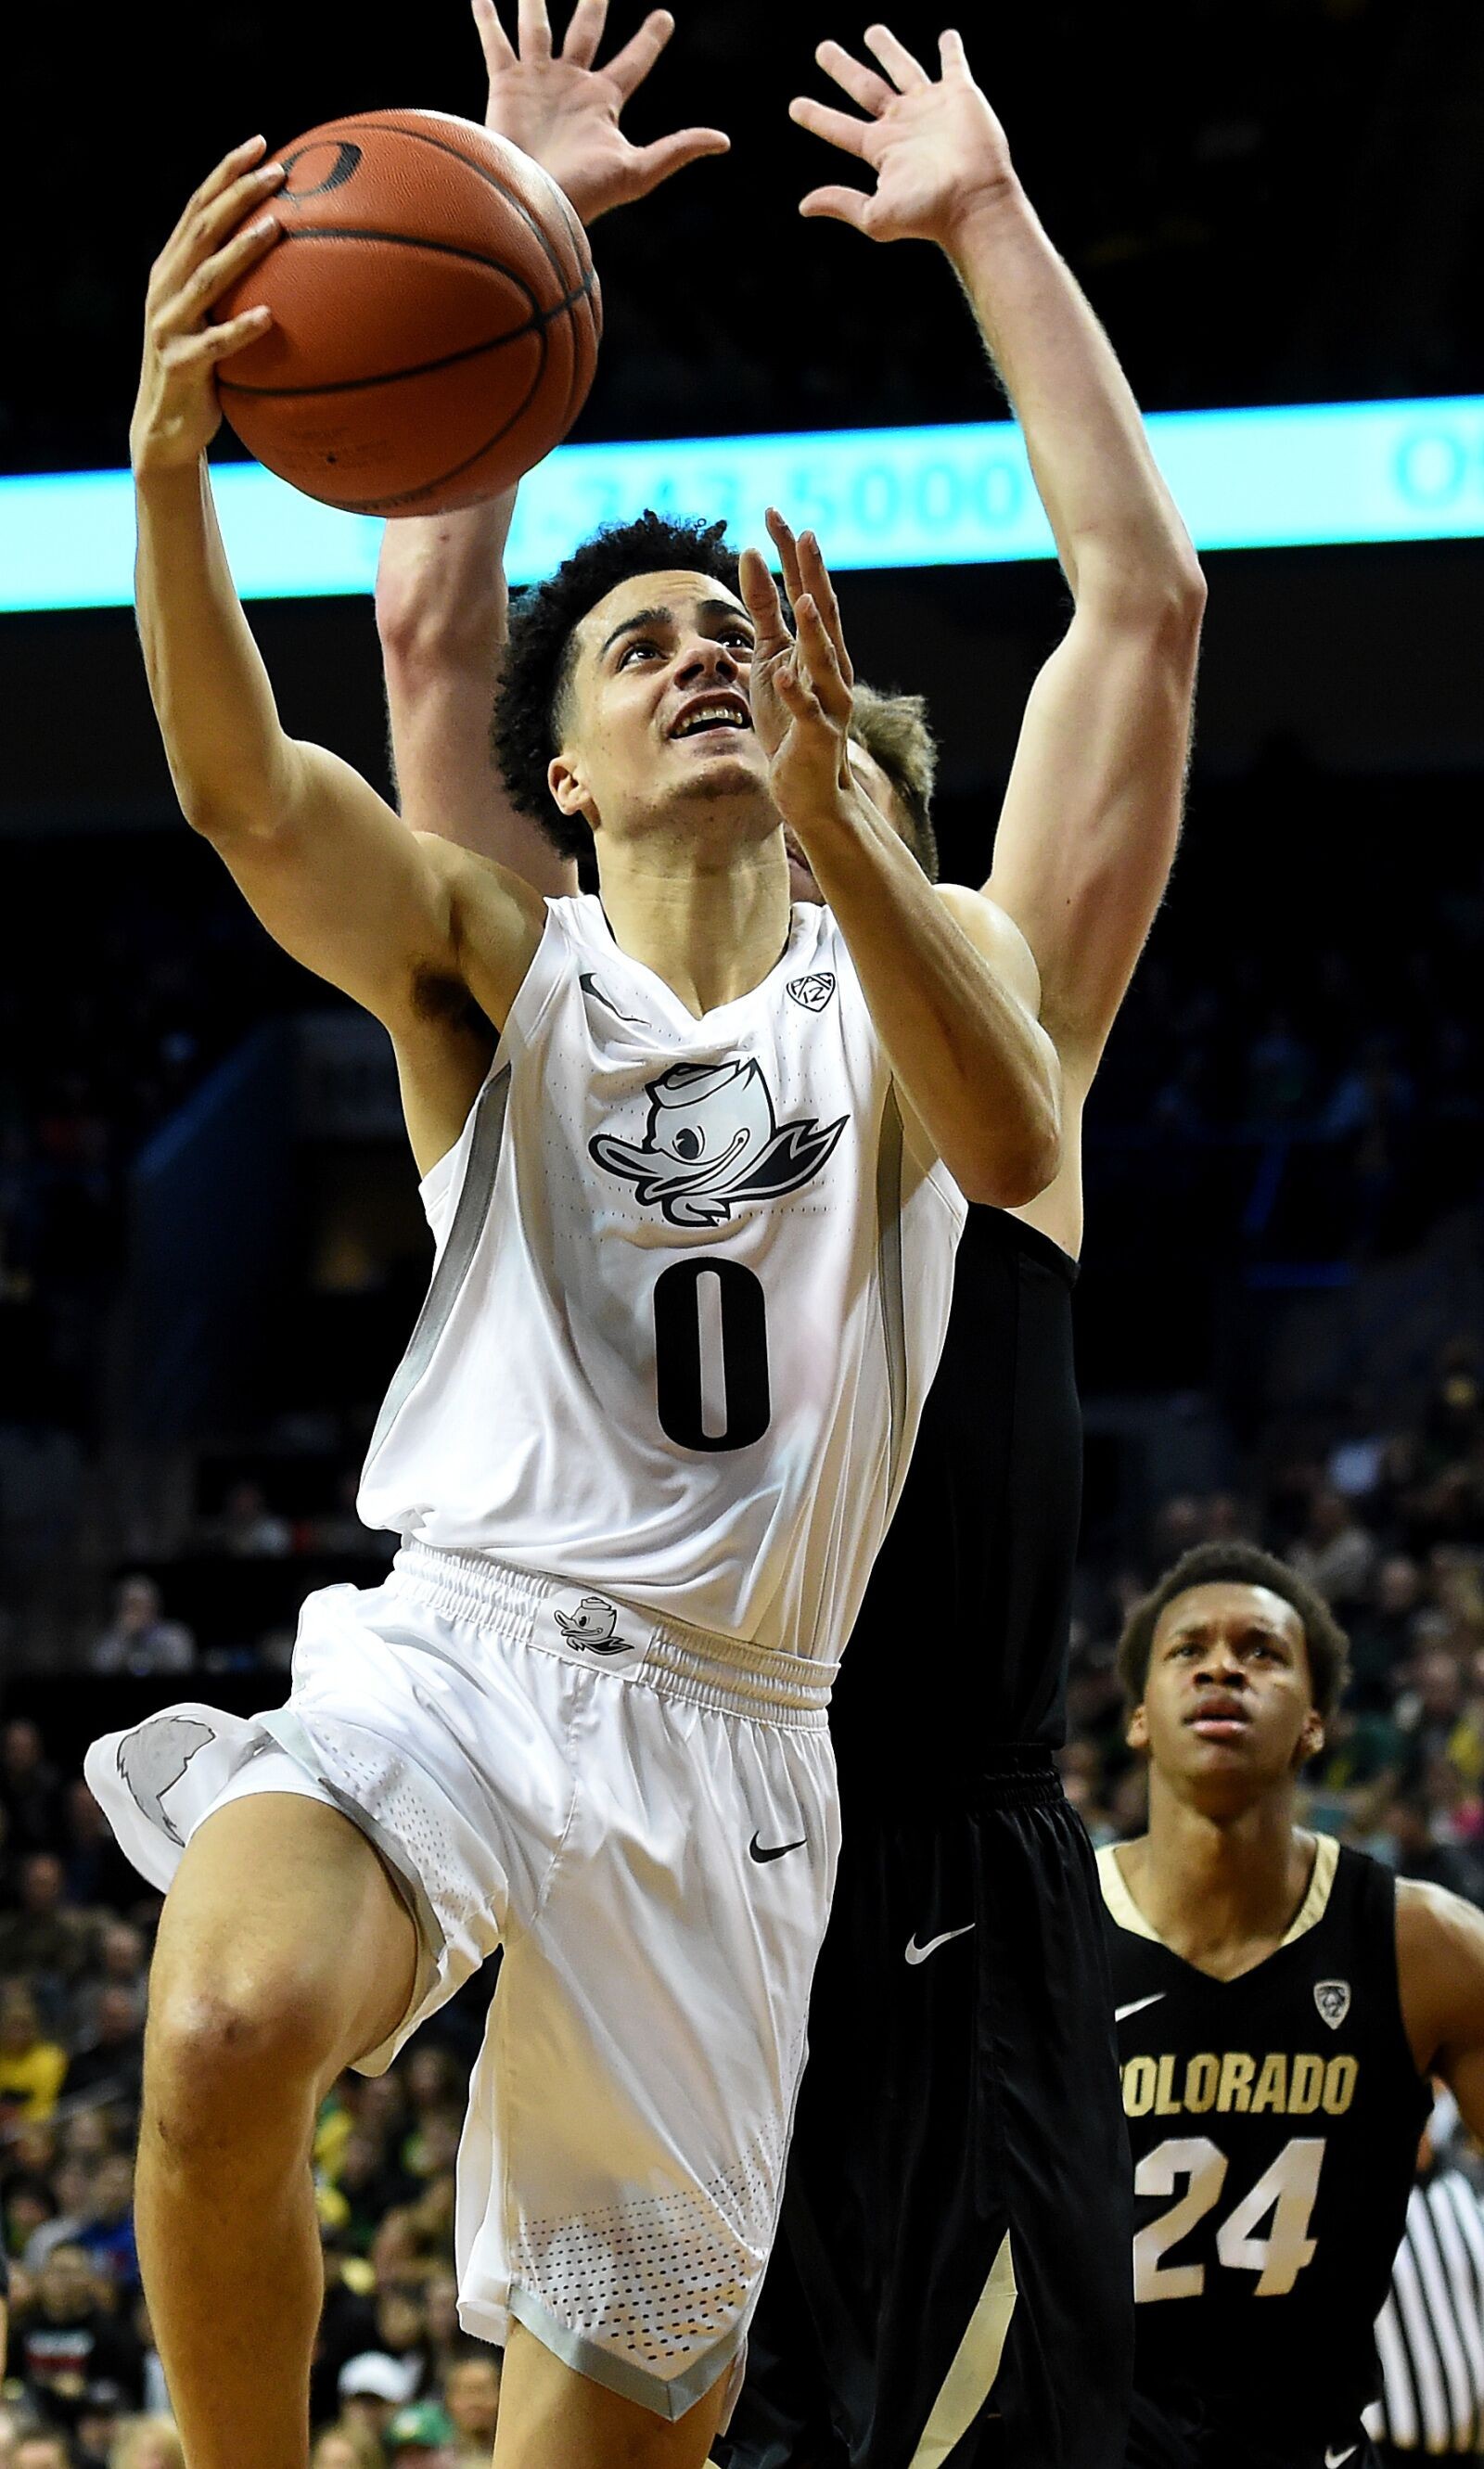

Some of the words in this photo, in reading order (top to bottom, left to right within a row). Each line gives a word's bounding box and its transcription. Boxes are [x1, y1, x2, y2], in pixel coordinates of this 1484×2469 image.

[803, 987, 825, 1004] 12
[653, 1257, 771, 1452] 0
[1119, 2053, 1359, 2117] OLORADO
[1133, 2137, 1326, 2304] 24
